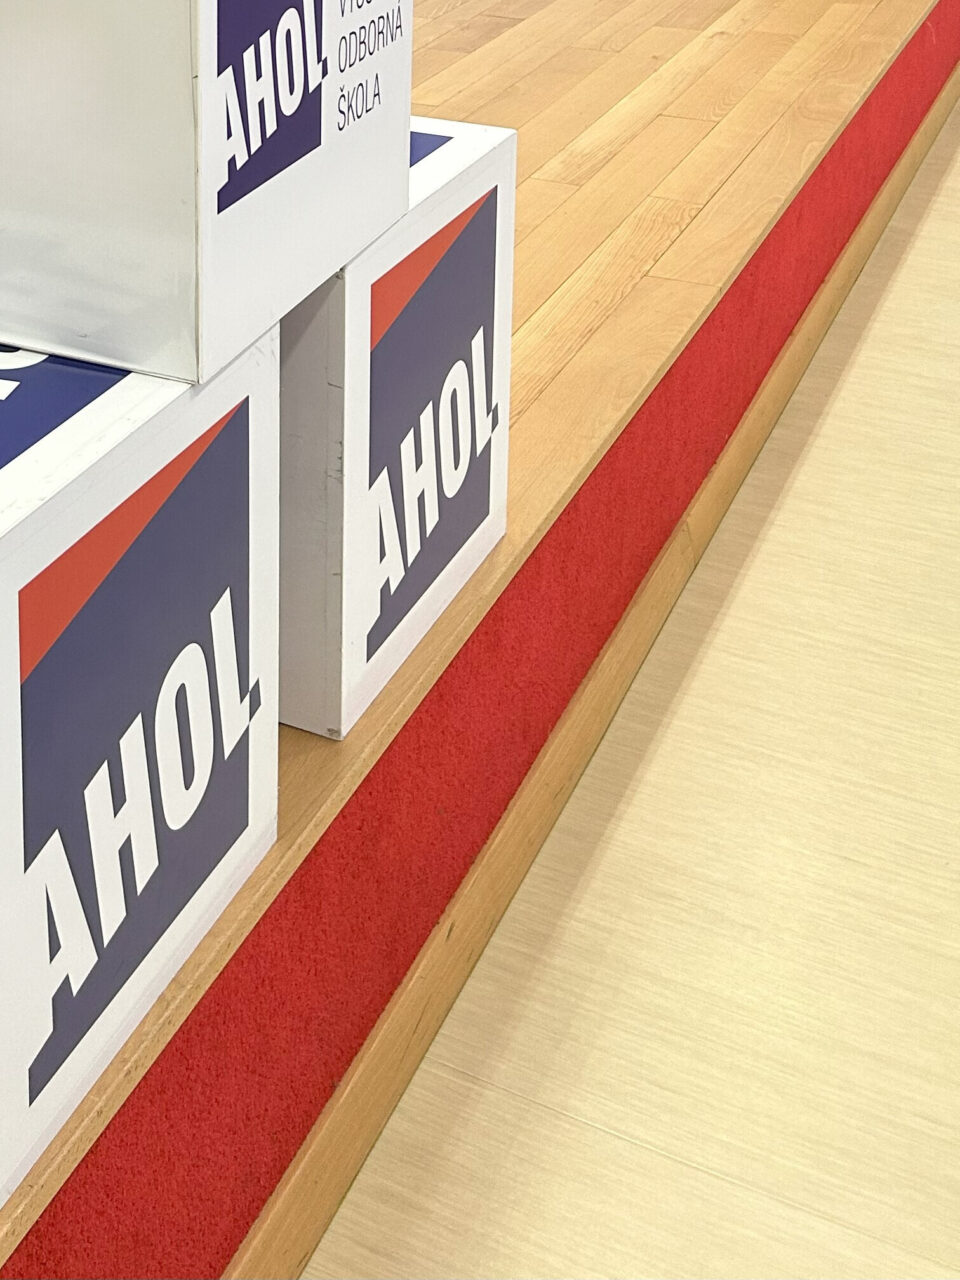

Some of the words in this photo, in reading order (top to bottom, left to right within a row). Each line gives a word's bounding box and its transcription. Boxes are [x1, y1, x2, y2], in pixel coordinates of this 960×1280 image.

[337, 72, 382, 132] ŠKOLA
[367, 324, 499, 636] AHOL
[24, 586, 262, 1070] AHOL
